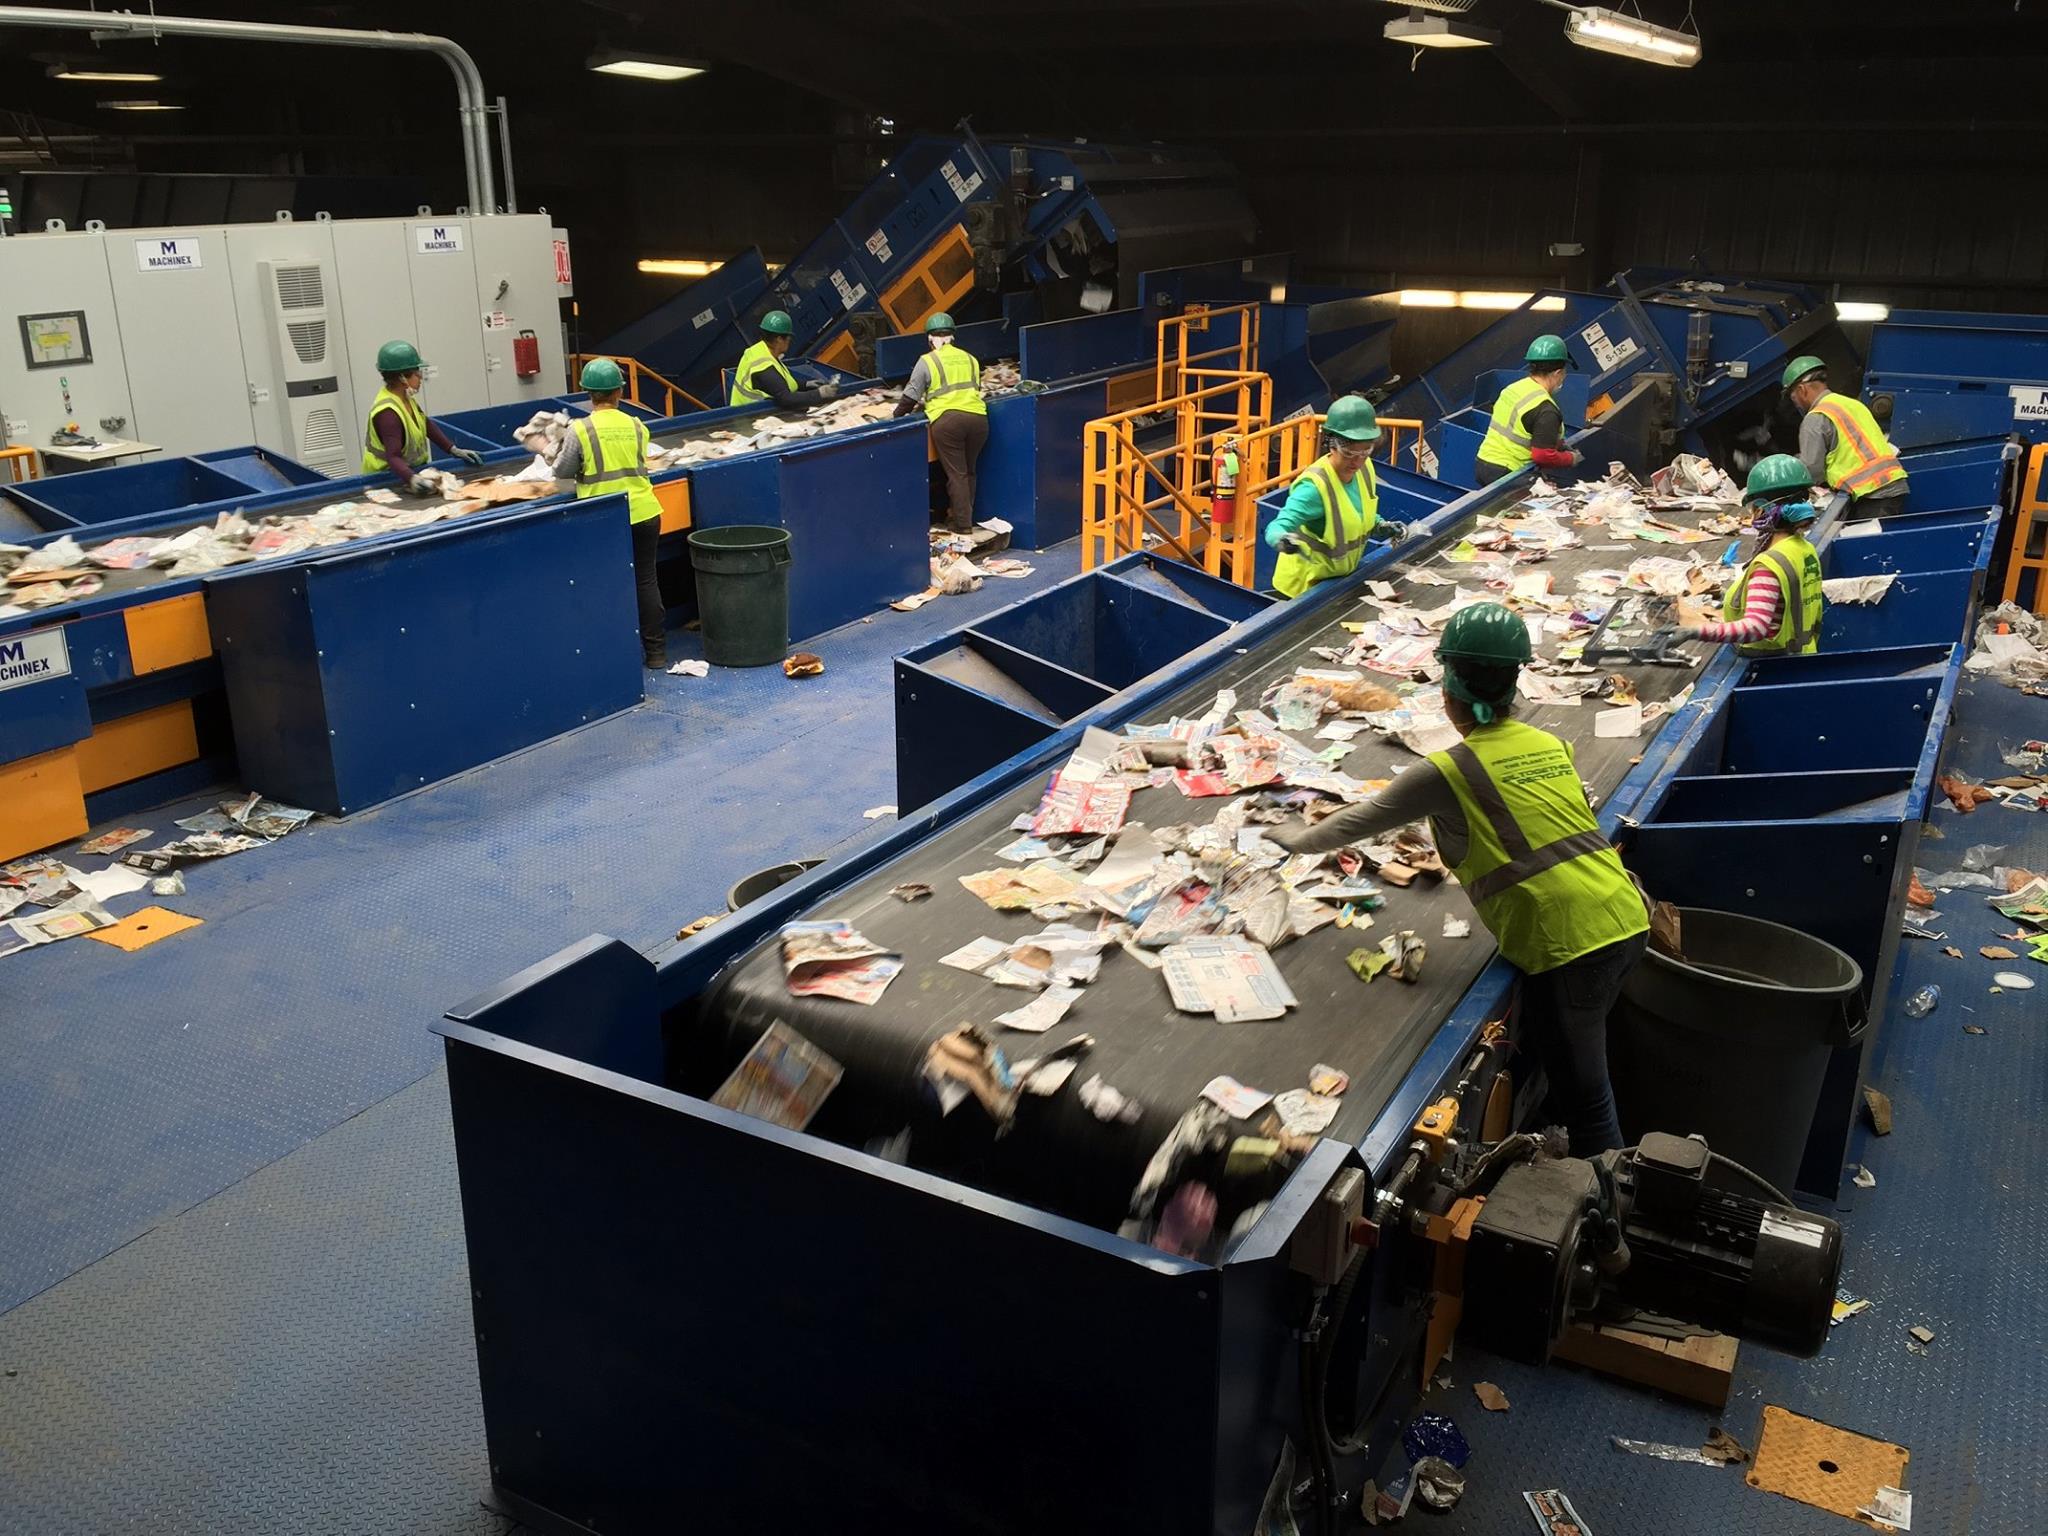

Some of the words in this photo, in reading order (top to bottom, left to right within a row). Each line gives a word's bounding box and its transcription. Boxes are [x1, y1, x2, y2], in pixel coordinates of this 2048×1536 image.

[434, 228, 446, 240] M
[161, 241, 177, 255] M
[148, 256, 192, 266] MACHINEX
[1605, 344, 1628, 362] S-13C
[2020, 405, 2048, 415] MACH
[0, 641, 25, 666] M
[0, 657, 50, 681] CHINEX
